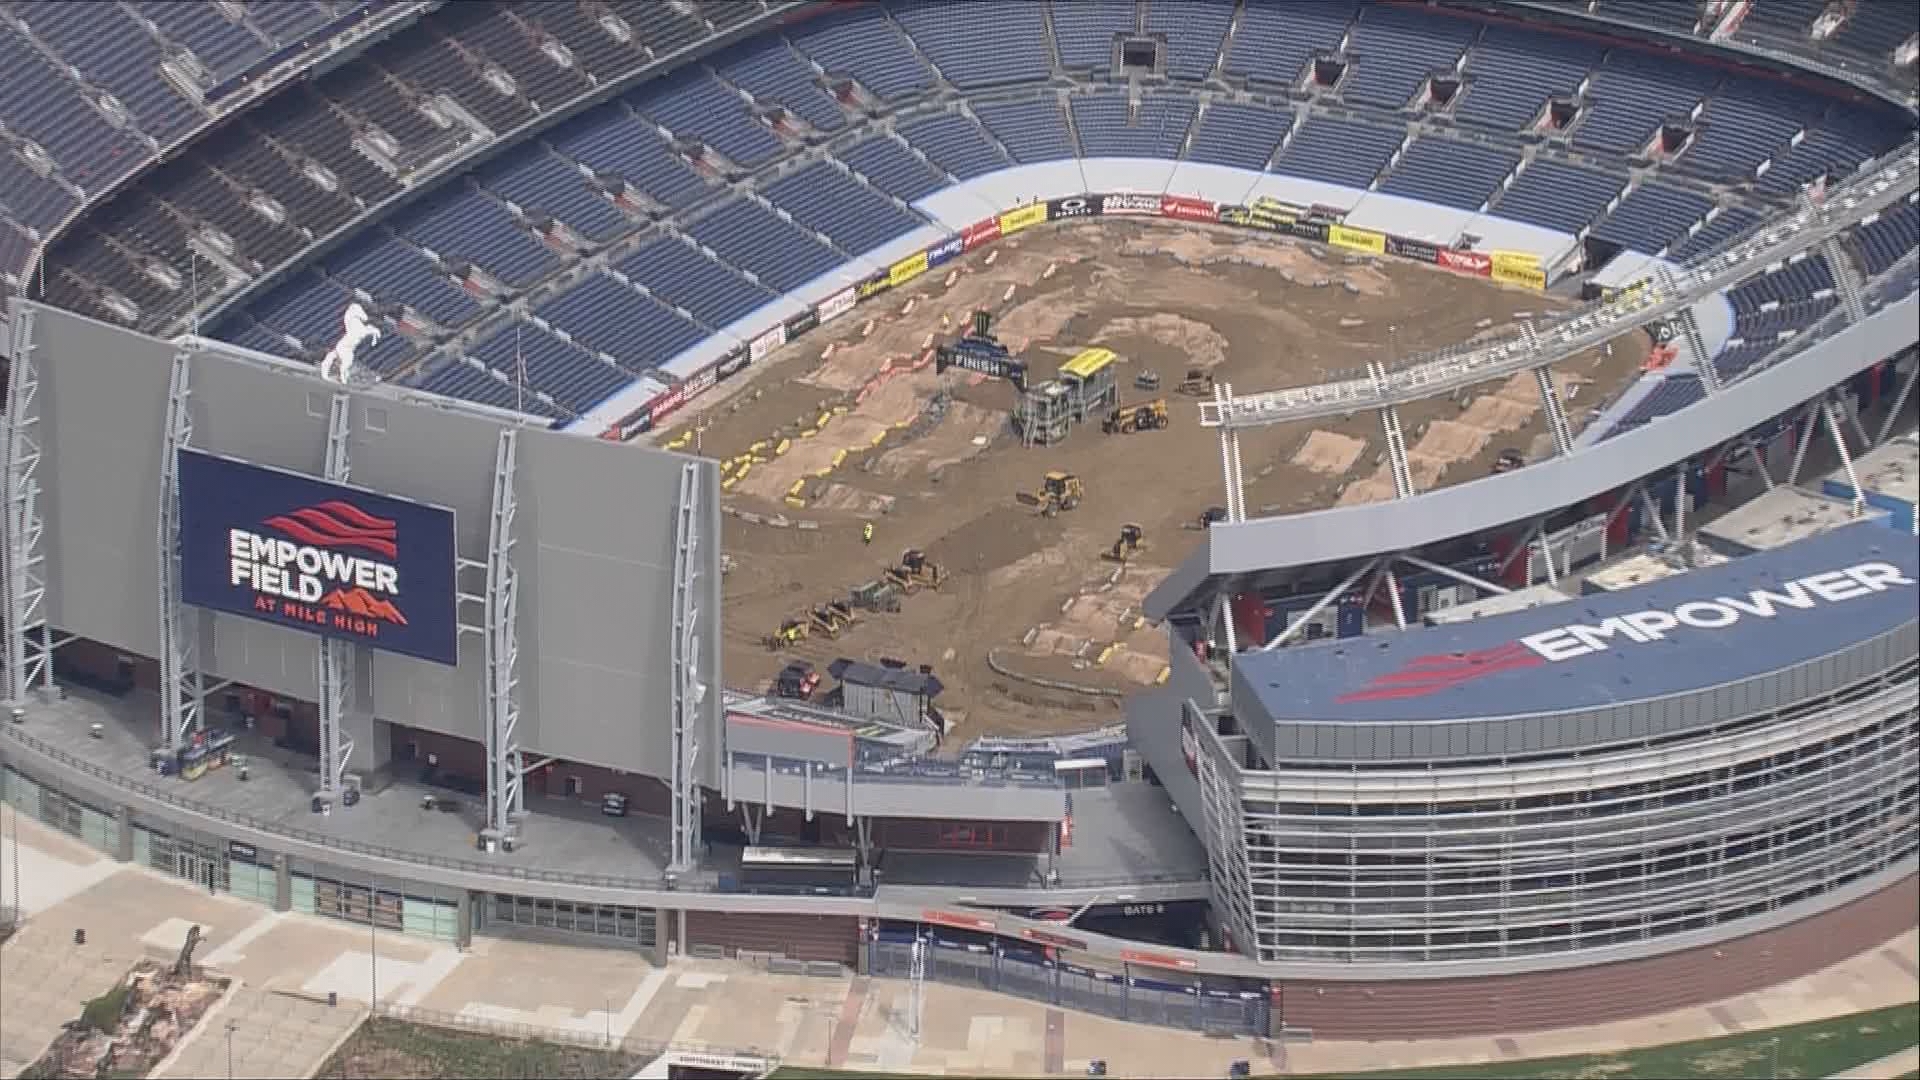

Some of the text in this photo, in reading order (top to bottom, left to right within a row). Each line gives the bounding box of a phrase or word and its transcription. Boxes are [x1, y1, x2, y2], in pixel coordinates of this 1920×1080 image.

[955, 353, 1000, 376] FINISH
[229, 528, 399, 595] EMPOWER
[230, 558, 323, 604] FIELD
[255, 596, 378, 637] AT MILE HIGH
[1519, 562, 1917, 662] EMPOWER
